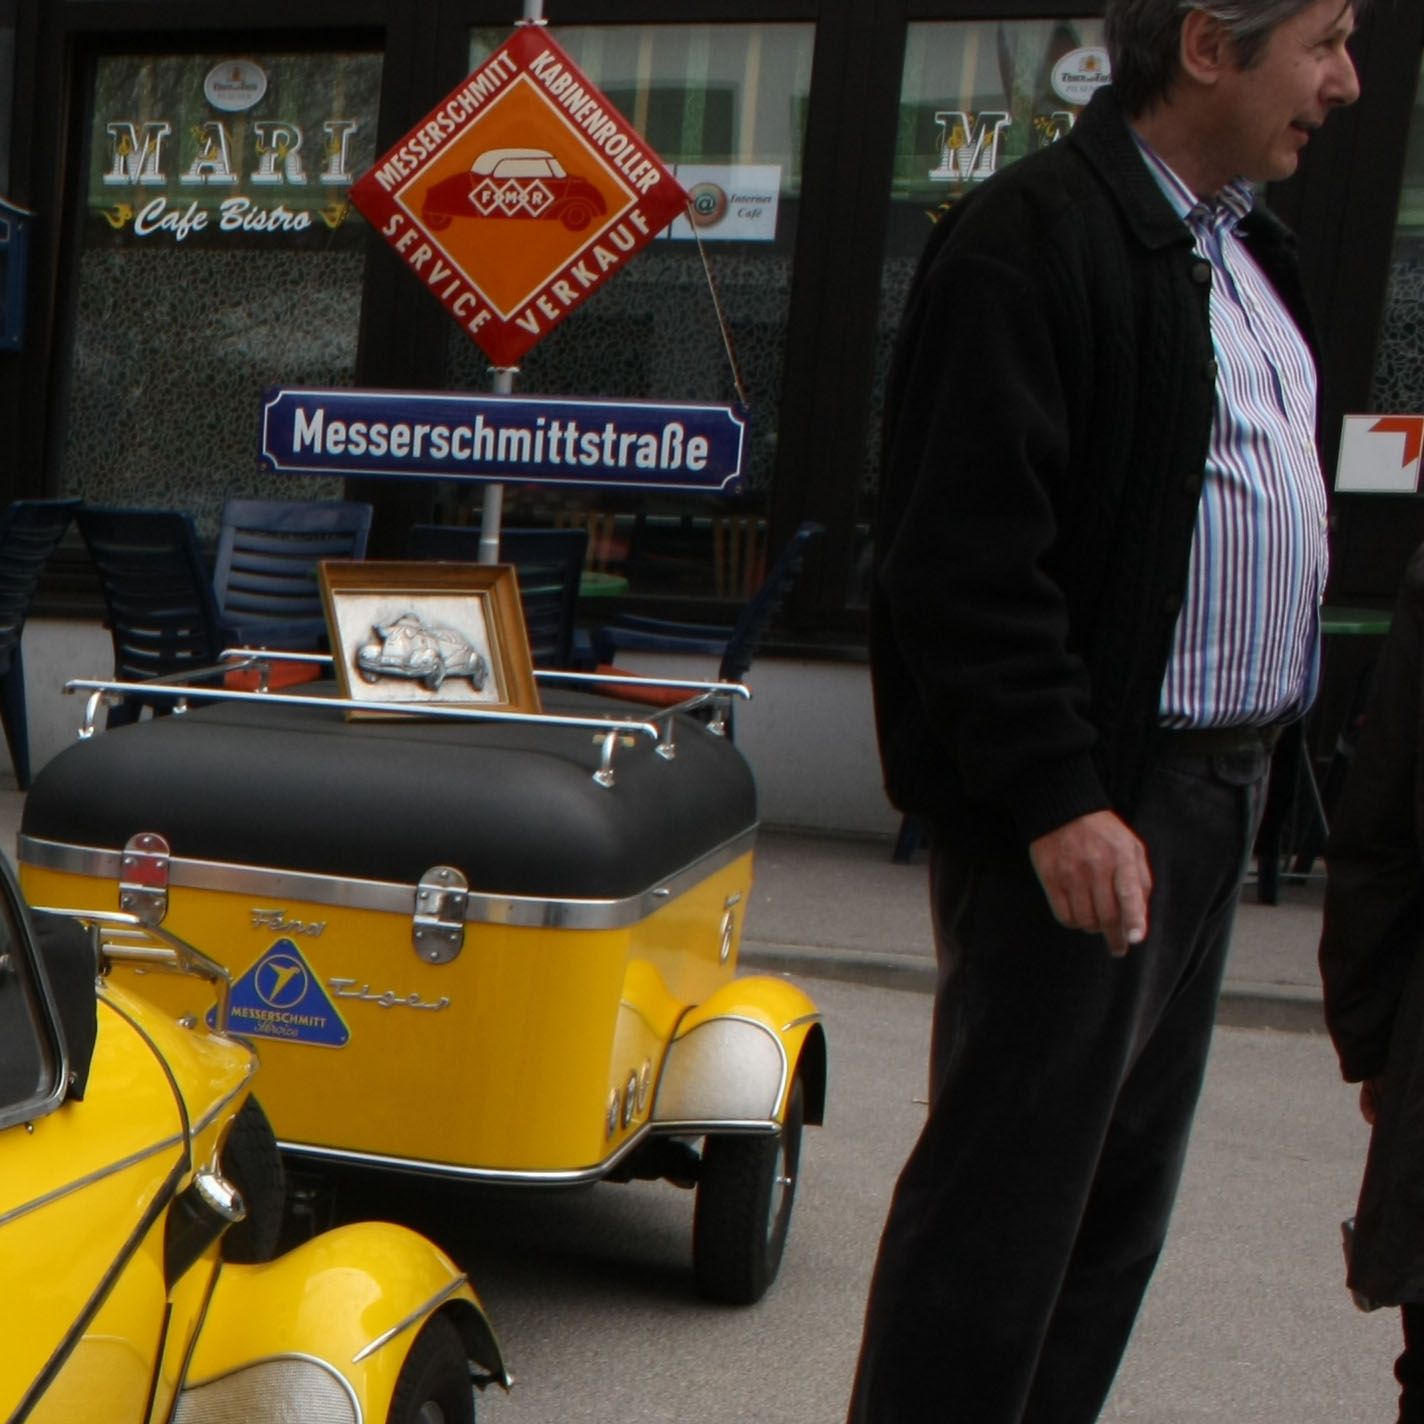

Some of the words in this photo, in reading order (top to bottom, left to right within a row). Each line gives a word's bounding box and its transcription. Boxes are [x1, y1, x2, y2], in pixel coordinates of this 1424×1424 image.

[103, 118, 358, 186] MARI
[374, 49, 519, 192] MESSERSCHMITT
[529, 50, 662, 194] KABINENROLLER
[134, 196, 209, 242] Cafe
[219, 195, 312, 233] Bistro
[729, 192, 773, 204] Internet
[381, 213, 493, 335] SERVICE
[515, 208, 652, 335] VERKAUF
[292, 407, 709, 471] Messerschmittstraße
[231, 1006, 328, 1029] MESSERSCHMITT
[328, 977, 451, 1012] Tiger
